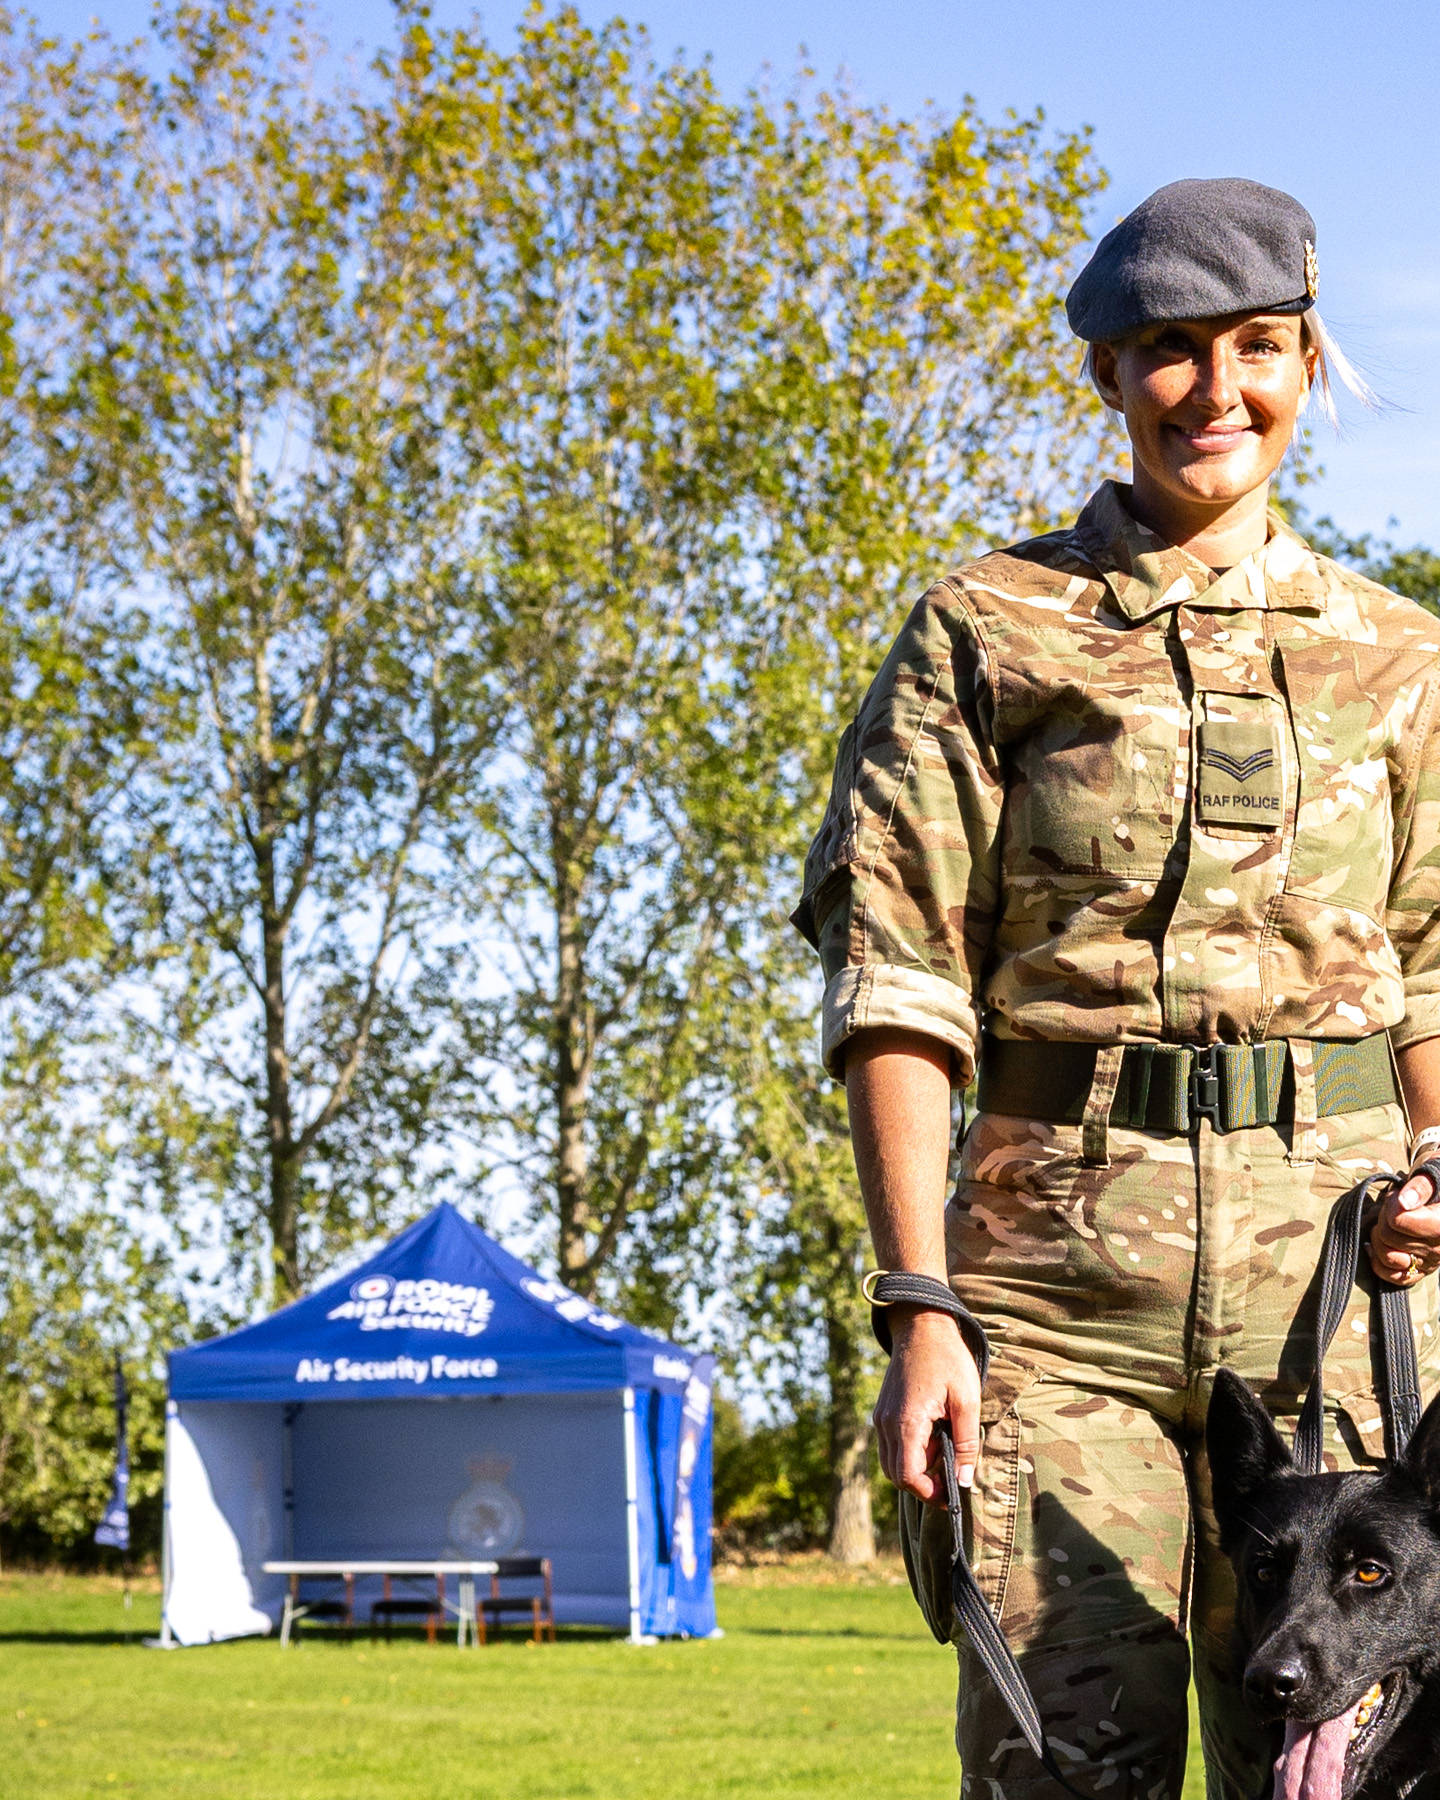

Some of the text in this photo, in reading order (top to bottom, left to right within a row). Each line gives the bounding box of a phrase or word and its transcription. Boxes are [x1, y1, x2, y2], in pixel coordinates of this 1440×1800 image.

[1202, 794, 1280, 810] RAF POLICE
[392, 1278, 489, 1305] ROYAL
[326, 1296, 495, 1322] AIR FORCE
[359, 1313, 488, 1337] Security
[295, 1354, 499, 1384] Air Security Force
